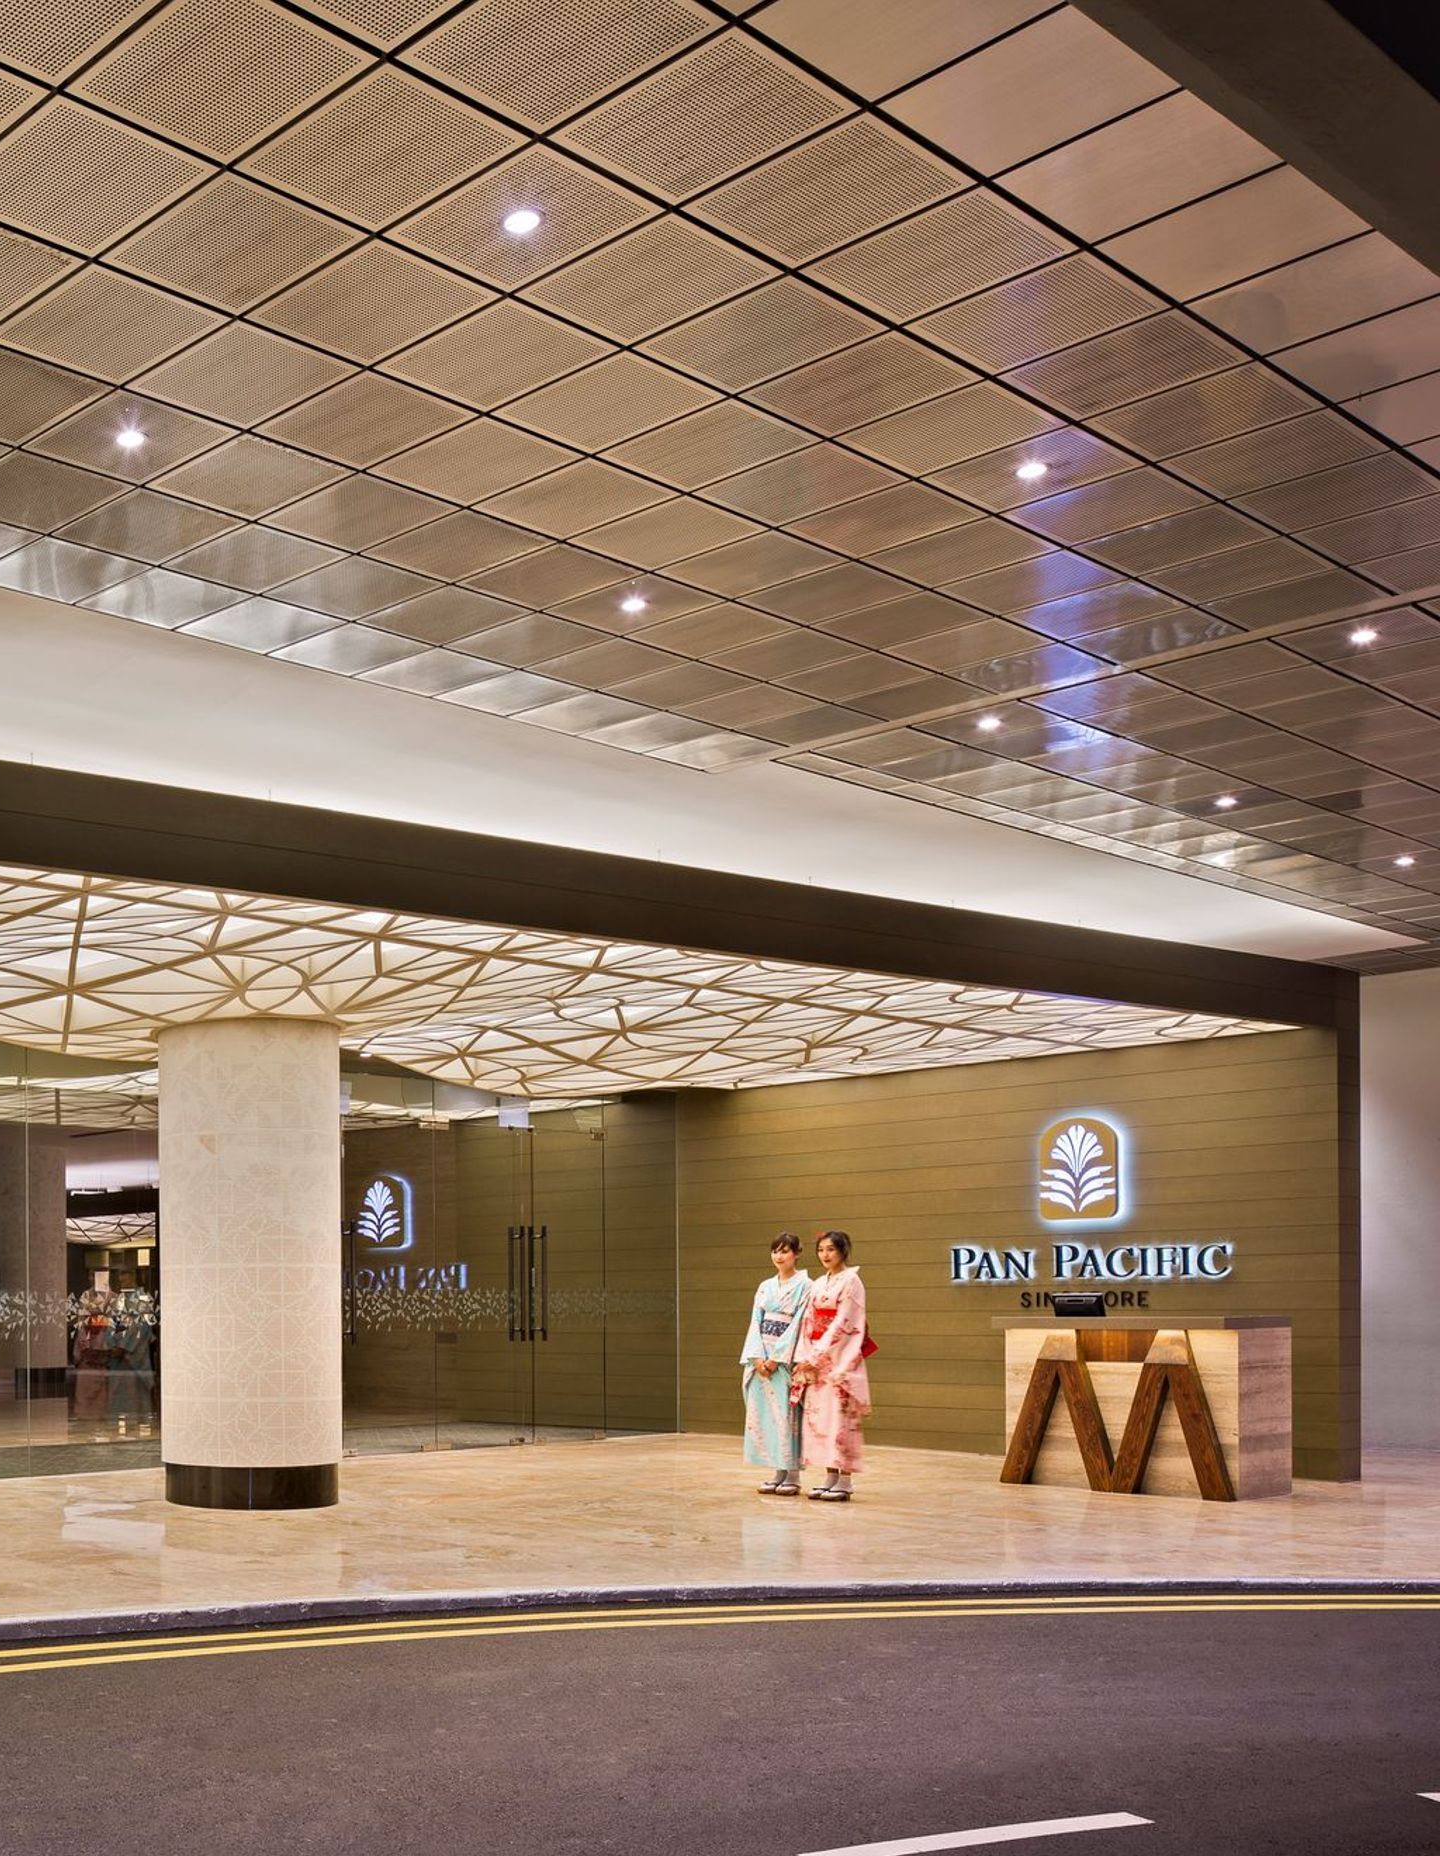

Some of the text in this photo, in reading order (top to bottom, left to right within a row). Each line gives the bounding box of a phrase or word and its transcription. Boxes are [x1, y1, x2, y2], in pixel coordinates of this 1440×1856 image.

[951, 1244, 1232, 1281] PAN PACIFIC
[1020, 1291, 1149, 1308] SINORE
